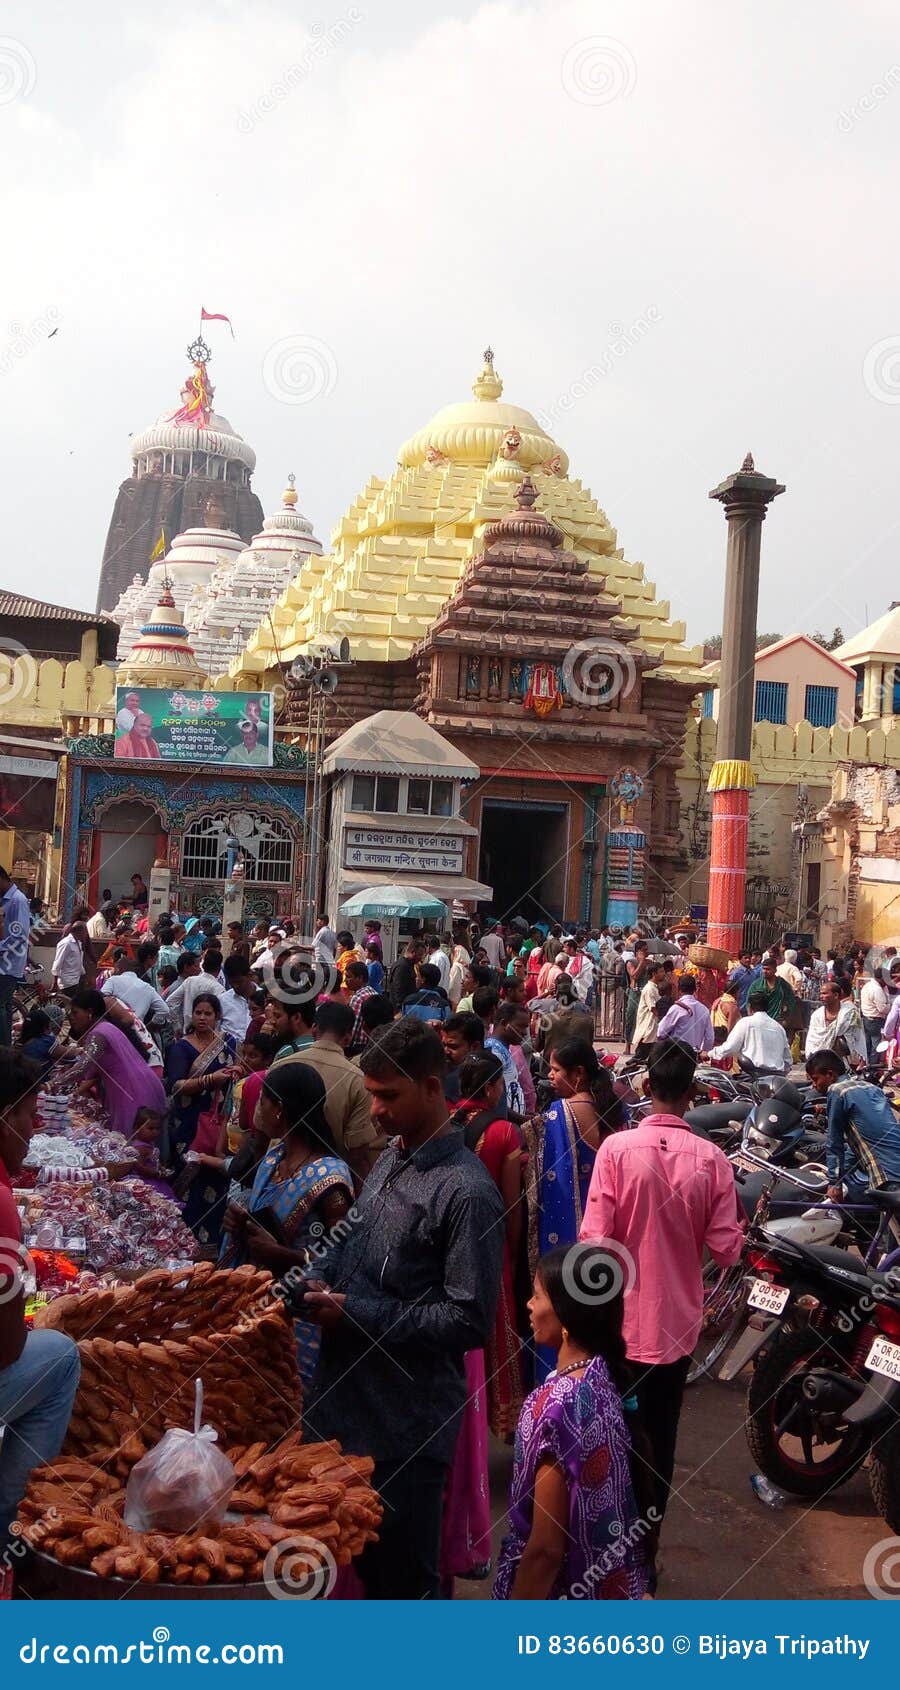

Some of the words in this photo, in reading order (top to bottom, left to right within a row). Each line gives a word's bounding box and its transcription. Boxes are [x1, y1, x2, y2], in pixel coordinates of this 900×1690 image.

[759, 1285, 771, 1295] OD
[771, 1288, 783, 1299] 02
[750, 1293, 759, 1303] K
[759, 1297, 783, 1311] 9189
[881, 1345, 892, 1357] OR
[870, 1354, 882, 1368] BU
